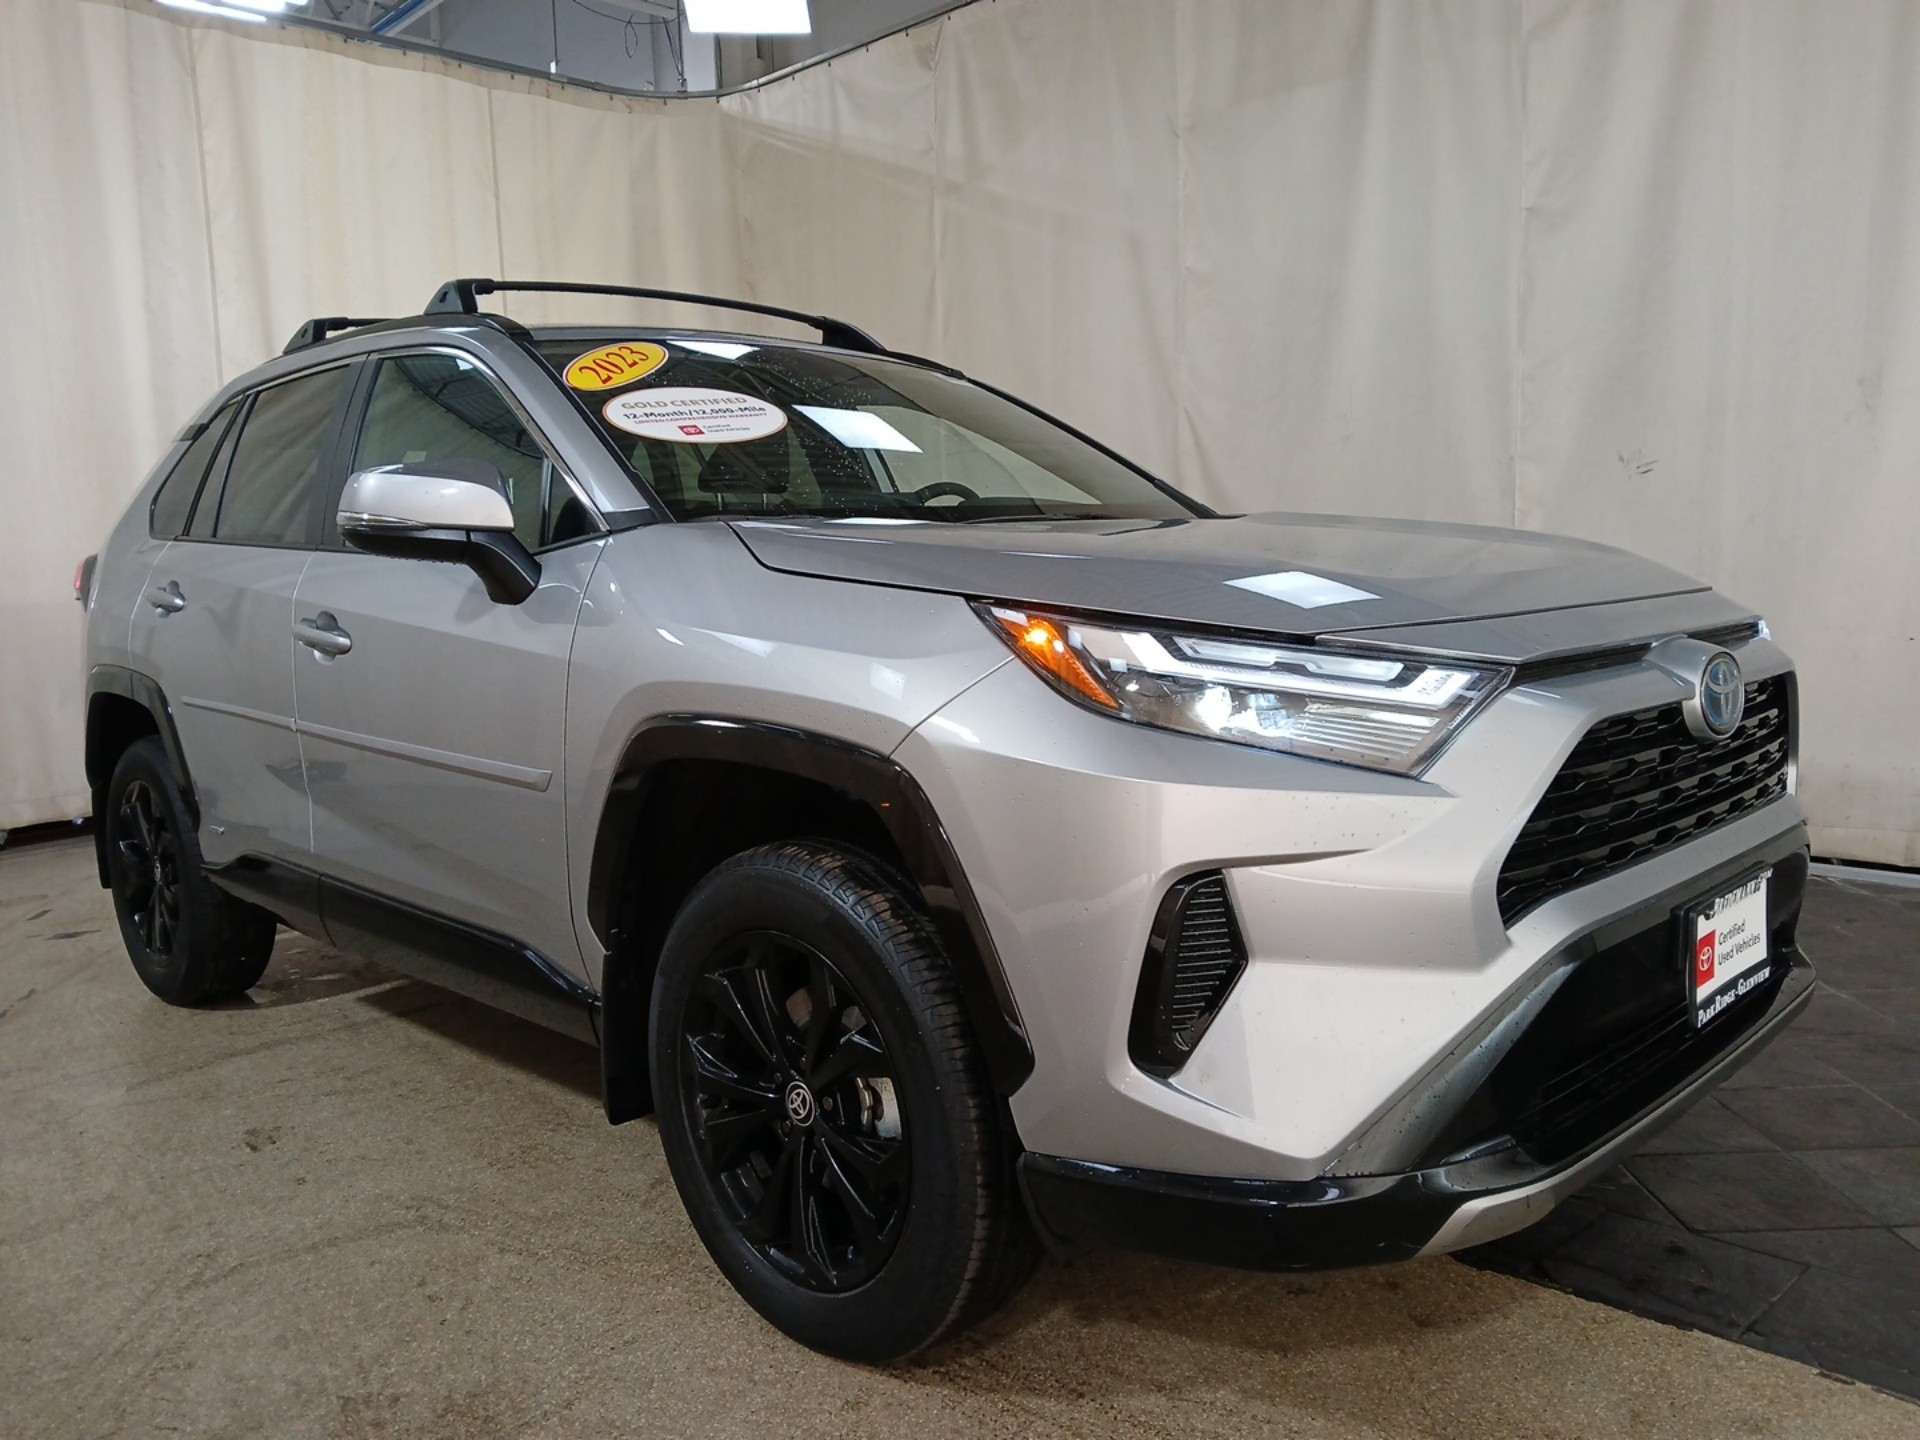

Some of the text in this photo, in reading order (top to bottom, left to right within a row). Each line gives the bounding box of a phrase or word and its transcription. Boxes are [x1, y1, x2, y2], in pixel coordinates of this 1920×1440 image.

[579, 345, 649, 385] 2023
[621, 397, 747, 409] GOLD CERTIFIED
[1718, 919, 1745, 946] Certified
[1718, 933, 1761, 966] Used Vehicles
